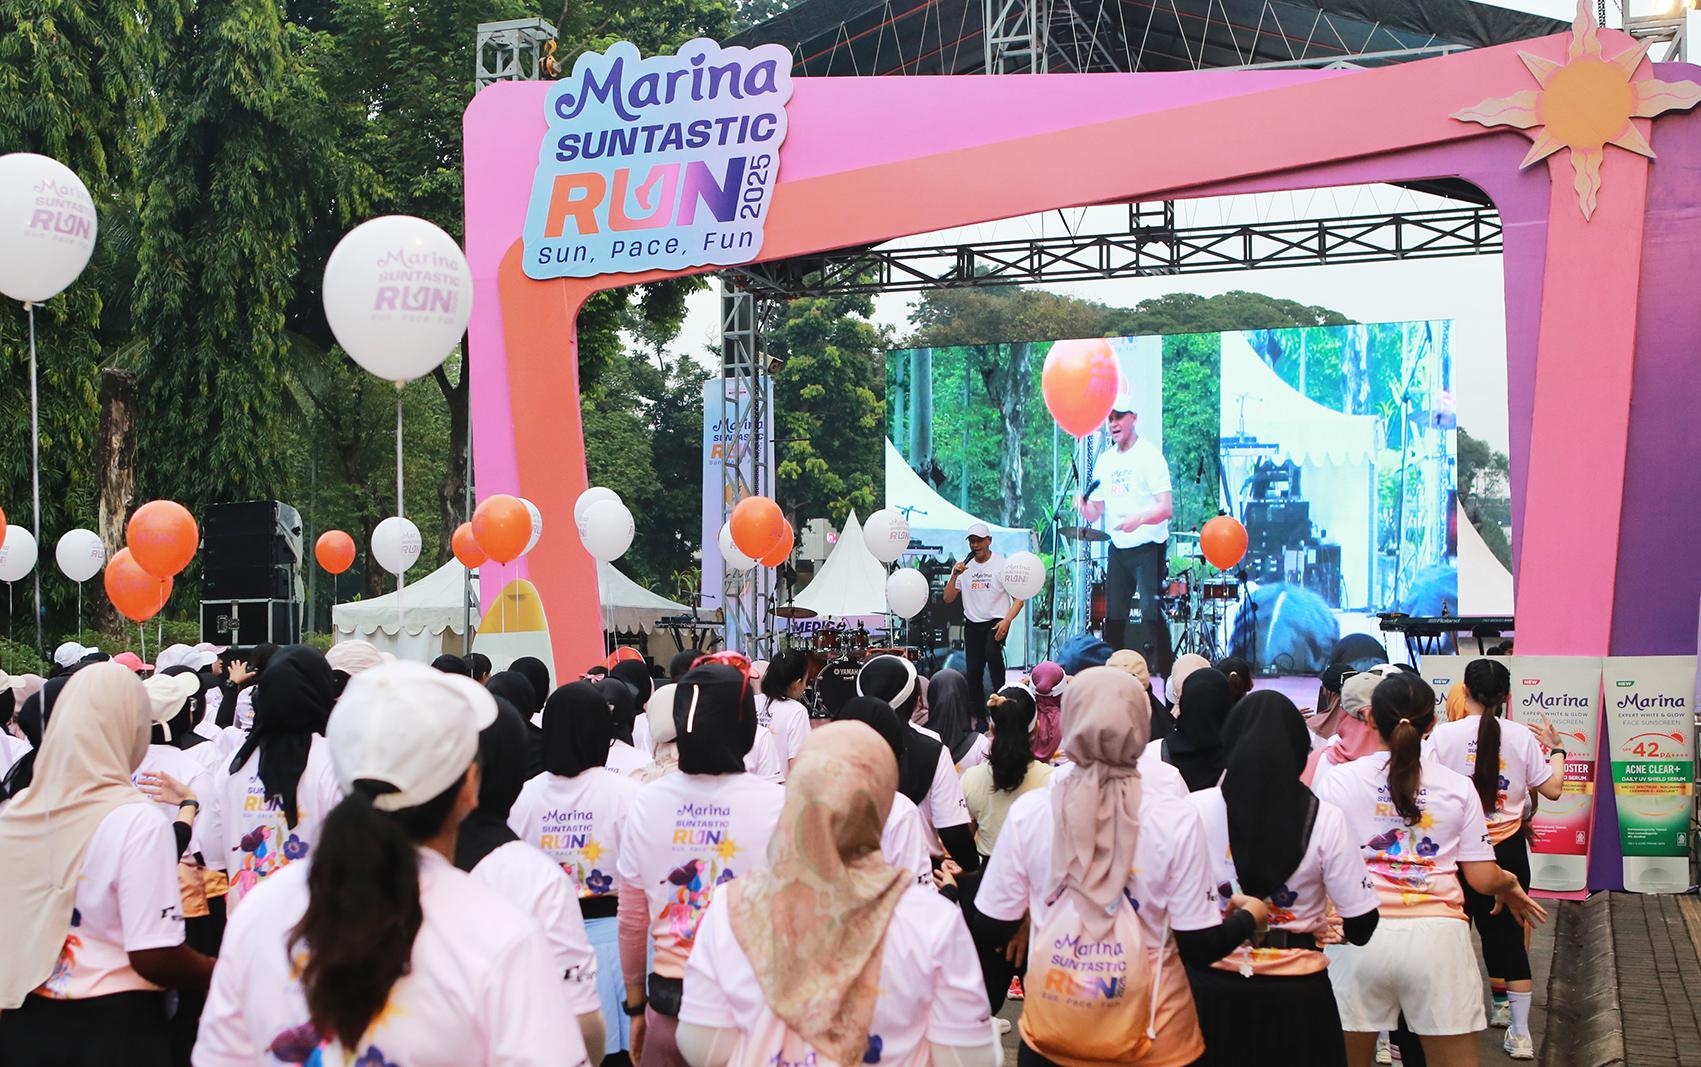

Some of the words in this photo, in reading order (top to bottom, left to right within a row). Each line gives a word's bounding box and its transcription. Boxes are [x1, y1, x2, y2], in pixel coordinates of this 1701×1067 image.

[555, 53, 778, 121] Marina
[555, 113, 777, 162] SUNTASTIC
[740, 153, 771, 219] 2025
[544, 156, 747, 238] RUN
[30, 208, 91, 240] RUN
[538, 245, 596, 264] Sun,
[611, 237, 687, 258] Pace,
[703, 231, 753, 251] Fun
[376, 248, 458, 271] Marina
[378, 271, 460, 287] SUNTASTIC
[374, 286, 452, 313] RUN
[1522, 691, 1588, 709] Marina
[1617, 693, 1685, 711] Marina
[1632, 742, 1659, 757] 42
[1564, 764, 1588, 773] OSTER
[1625, 765, 1647, 774] ACNE
[1648, 765, 1681, 774] CLEAR+
[542, 809, 593, 824] Marina
[676, 803, 730, 818] Marina
[676, 820, 729, 828] SUNTASTIC
[541, 834, 586, 849] RUN
[672, 829, 721, 845] RUN
[1054, 933, 1124, 959] Marina
[1051, 954, 1127, 972] SUNTASTIC
